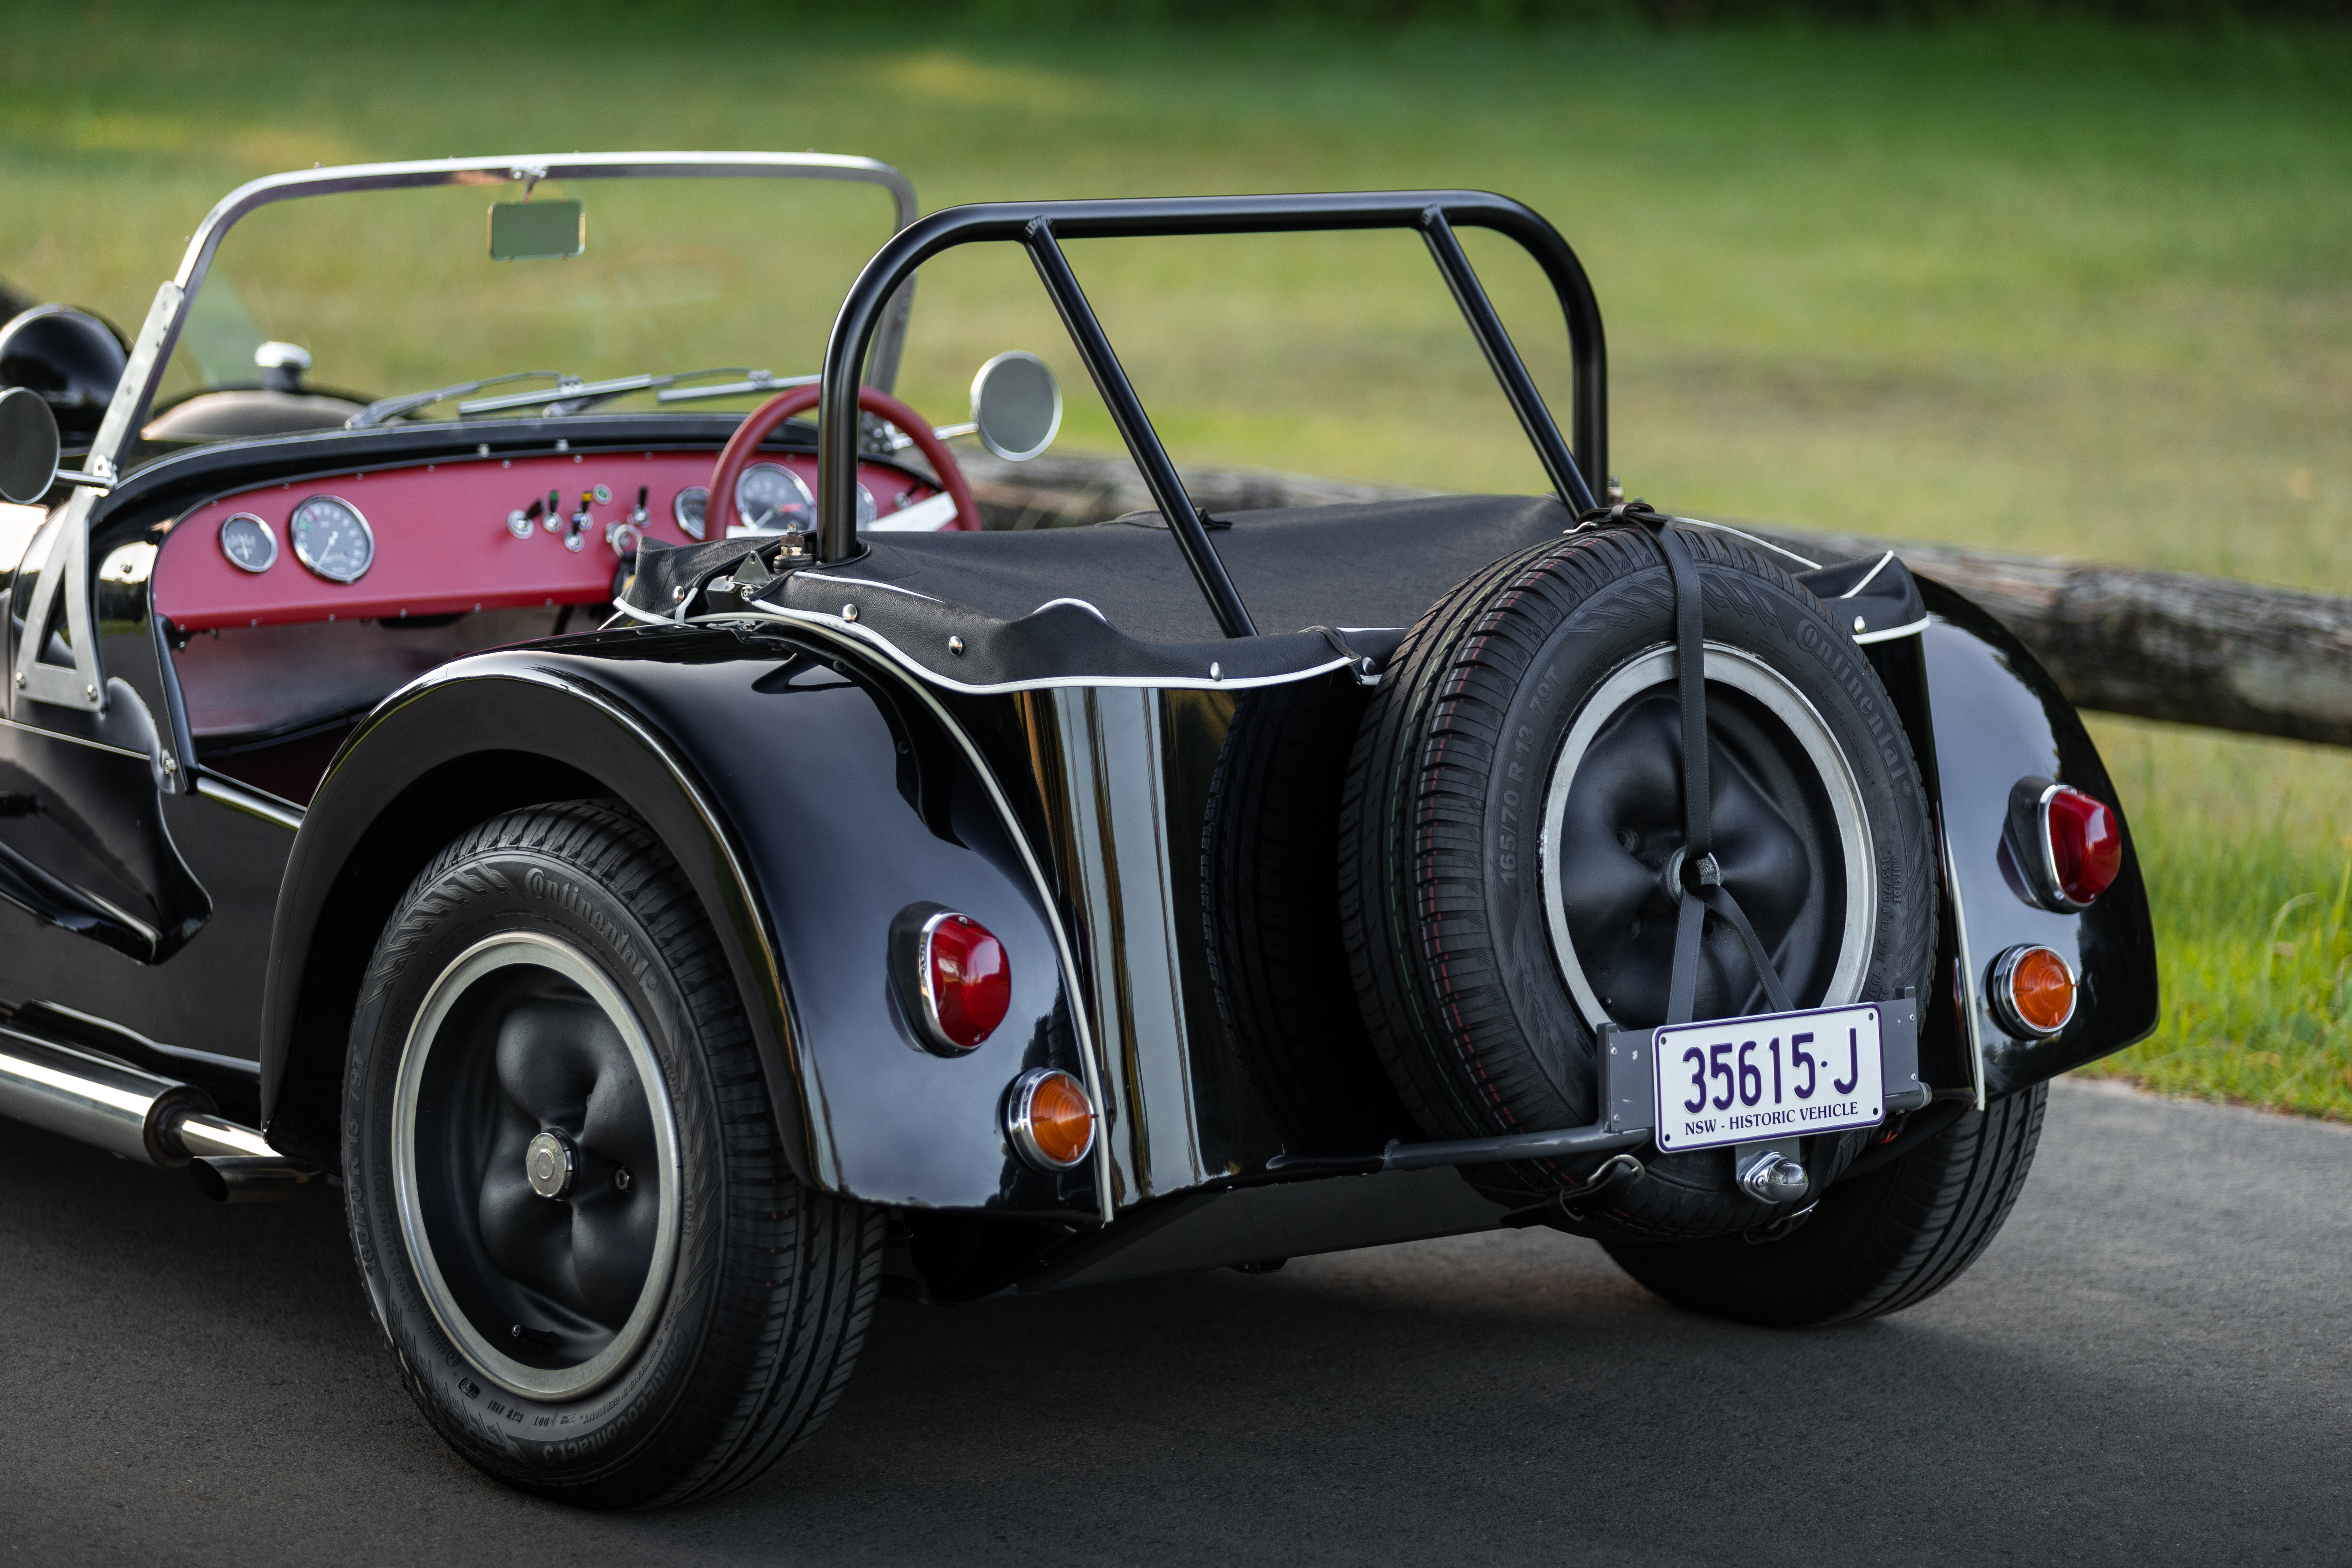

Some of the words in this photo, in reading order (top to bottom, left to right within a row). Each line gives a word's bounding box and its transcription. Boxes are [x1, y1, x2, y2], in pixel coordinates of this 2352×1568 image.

[1527, 664, 1564, 718] 79T
[1792, 613, 1908, 782] Continental
[1512, 721, 1537, 759] 13
[1506, 758, 1526, 784] R
[1499, 786, 1521, 884] 165/70
[1880, 858, 1891, 902] 165/70
[1890, 855, 1902, 904] OUTSIDE
[523, 865, 651, 983] Continental
[1880, 918, 1891, 933] 13
[1881, 906, 1891, 916] R
[347, 1047, 367, 1102] 79T
[347, 1118, 359, 1148] 13
[1685, 1119, 1717, 1135] NSW
[1730, 1109, 1795, 1130] HISTORIC
[1800, 1102, 1858, 1121] VEHICLE
[347, 1156, 360, 1177] R
[349, 1182, 378, 1279] 165/70
[378, 1209, 394, 1257] WARNING
[390, 1262, 408, 1301] SAFETY
[424, 1322, 445, 1356] 0223086
[626, 1334, 663, 1393] ENGINEERED
[559, 1321, 690, 1466] ContiEcoContact
[581, 1394, 621, 1424] GERMANY
[619, 1387, 629, 1400] IN
[532, 1414, 550, 1427] DOT
[543, 1444, 555, 1467] 3
